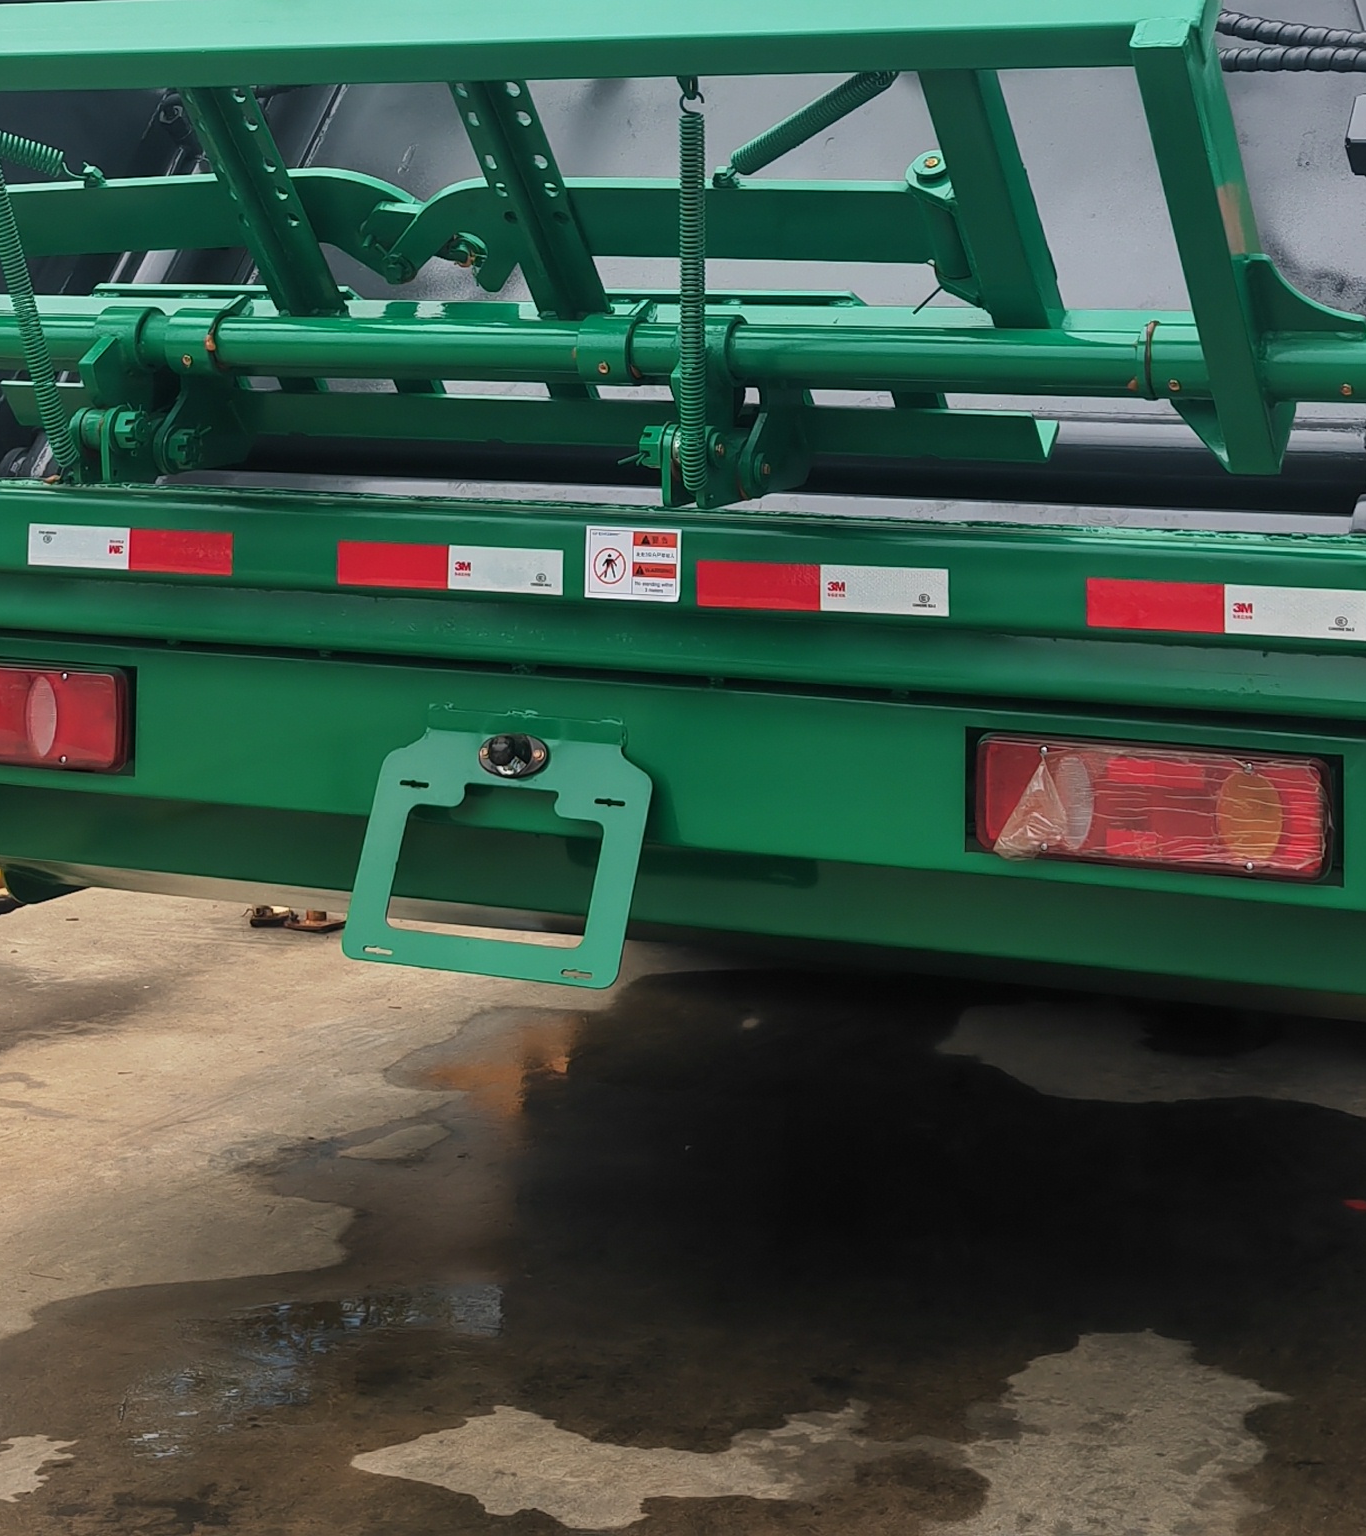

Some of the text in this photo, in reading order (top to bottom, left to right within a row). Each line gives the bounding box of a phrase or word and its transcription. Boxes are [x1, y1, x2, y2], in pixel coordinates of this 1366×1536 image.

[109, 545, 124, 554] 3M
[454, 561, 471, 572] 3M
[827, 581, 846, 592] 3M
[1232, 603, 1253, 614] 3M
